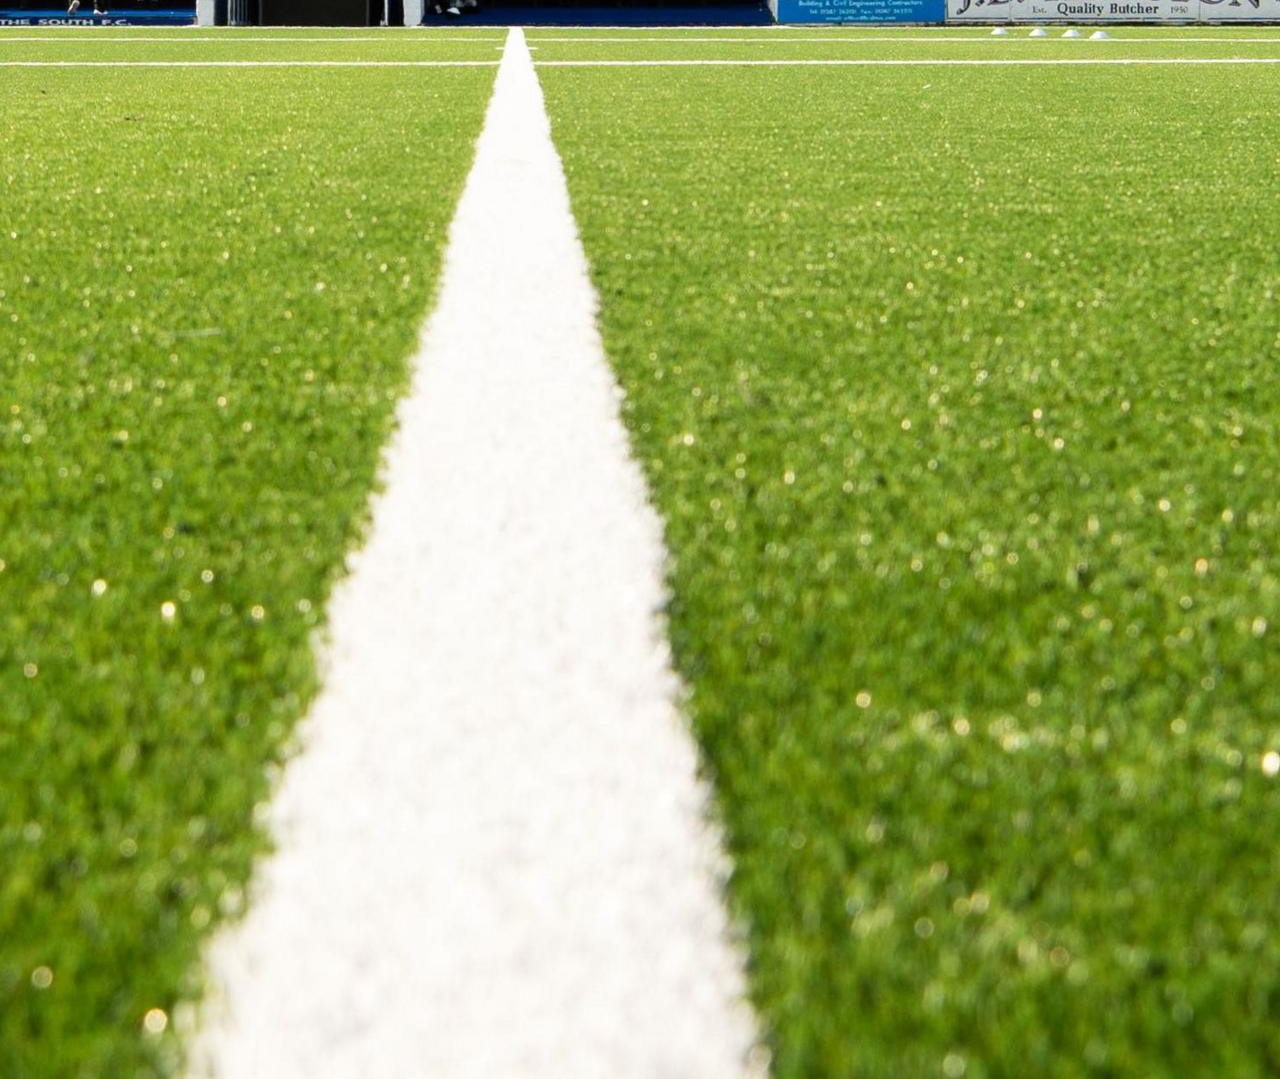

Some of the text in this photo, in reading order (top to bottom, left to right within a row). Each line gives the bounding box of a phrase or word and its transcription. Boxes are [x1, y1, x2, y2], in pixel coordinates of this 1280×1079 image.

[849, 0, 886, 8] Engineering
[1057, 2, 1104, 16] Quality
[1110, 2, 1160, 14] Butcher
[38, 18, 94, 26] SOUTH
